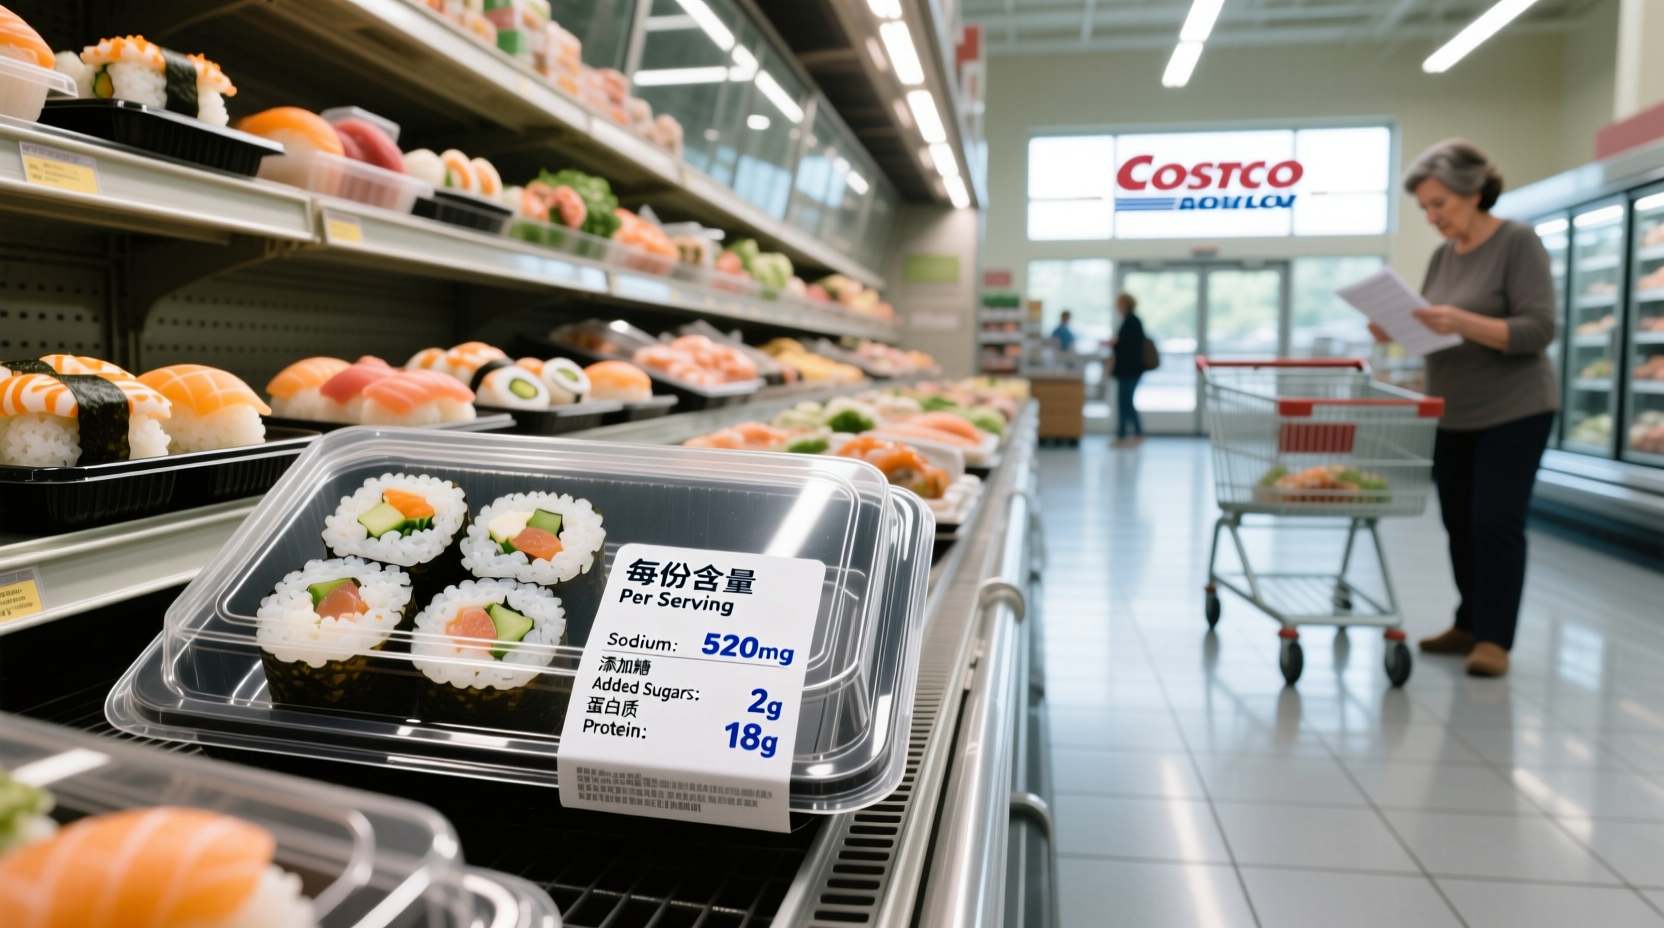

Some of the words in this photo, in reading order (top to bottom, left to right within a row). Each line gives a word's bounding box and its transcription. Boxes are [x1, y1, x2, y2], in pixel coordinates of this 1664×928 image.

[1117, 155, 1304, 191] COSTCO
[626, 557, 757, 595] 每份含量
[618, 588, 654, 606] Per
[657, 591, 735, 617] Serving
[606, 632, 678, 652] Sodium:
[701, 632, 795, 667] 520mg
[585, 696, 640, 719] 蛋白质
[591, 676, 640, 695] Added
[642, 681, 700, 702] Sugars:
[747, 688, 783, 721] 2g
[582, 718, 647, 740] Protein:
[724, 721, 779, 759] 18g
